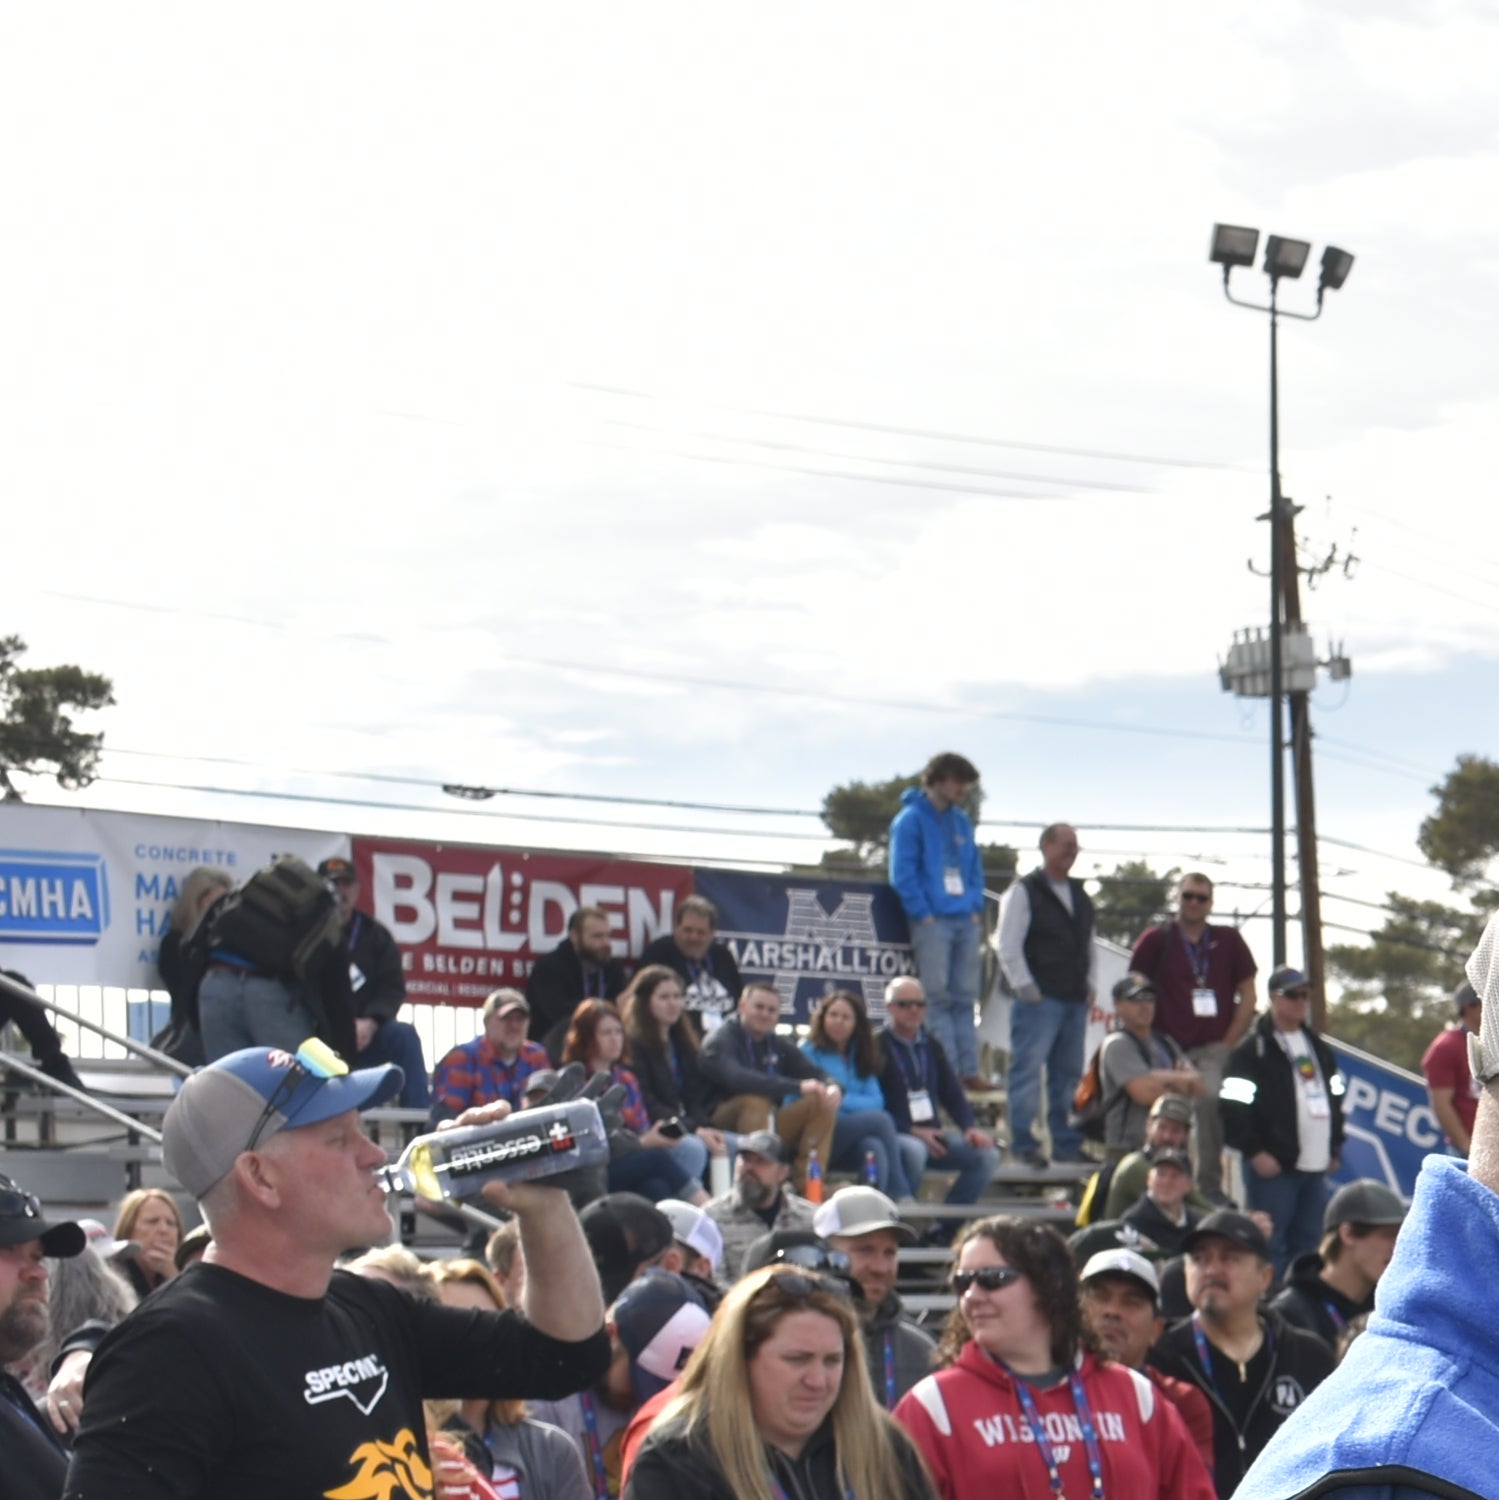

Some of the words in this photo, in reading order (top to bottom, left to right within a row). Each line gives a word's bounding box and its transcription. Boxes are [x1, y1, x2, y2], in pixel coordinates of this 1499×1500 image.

[134, 843, 237, 866] CONCRETE
[0, 873, 94, 919] MHA
[372, 853, 675, 958] BELDEN
[423, 953, 504, 977] BELDEN
[1337, 1070, 1440, 1149] PEC
[304, 1361, 361, 1394] SPEC
[973, 1411, 1126, 1447] WISONIN
